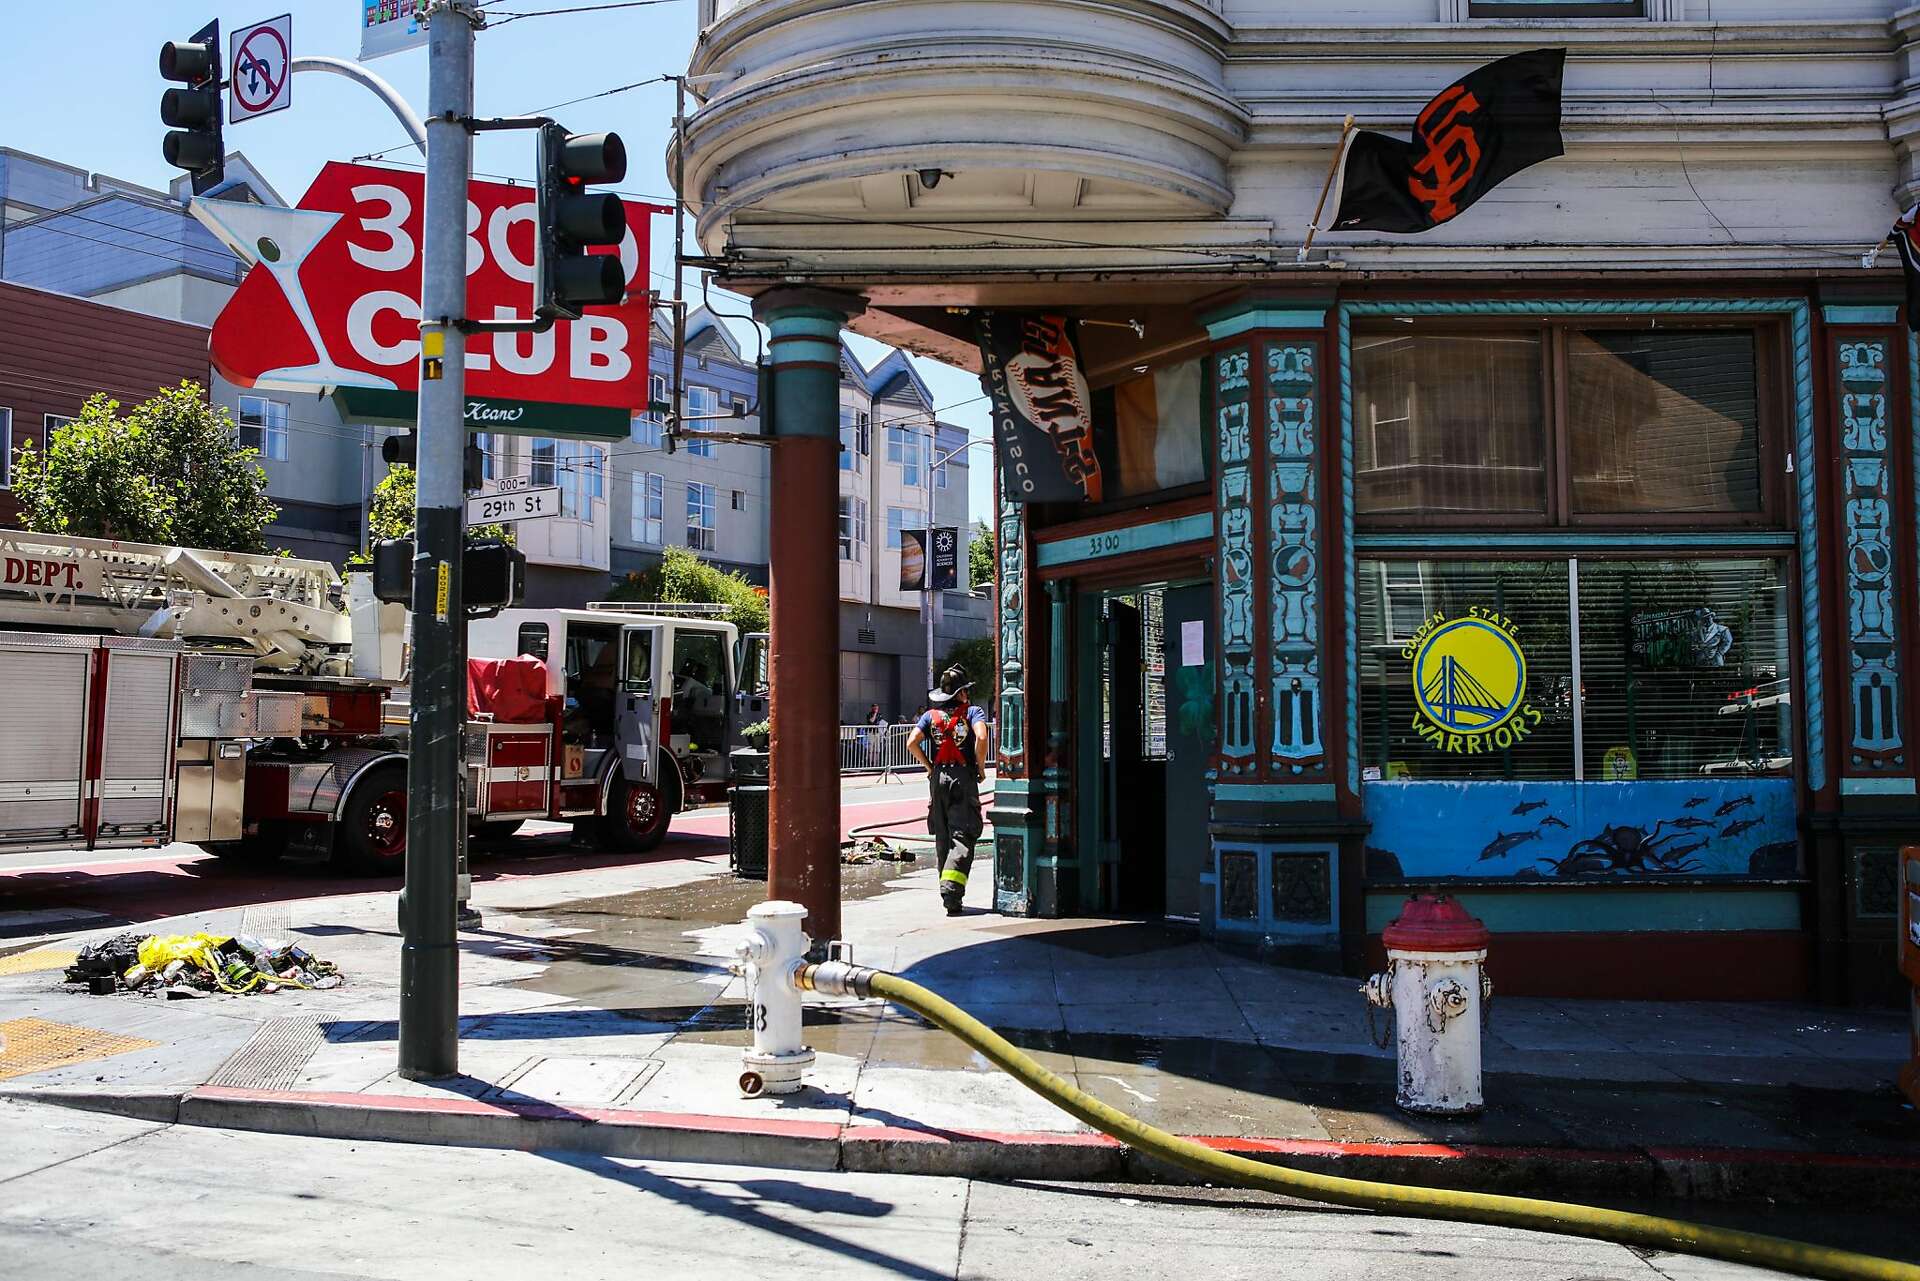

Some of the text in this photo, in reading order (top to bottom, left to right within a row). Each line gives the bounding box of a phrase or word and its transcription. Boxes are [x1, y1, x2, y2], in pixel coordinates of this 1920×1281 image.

[464, 402, 524, 421] Keane
[500, 479, 518, 491] 000
[483, 496, 542, 518] 29th St
[4, 558, 84, 589] DEPT.
[1401, 606, 1520, 660] GOLDEN STATE
[1411, 704, 1542, 754] WARRIORS
